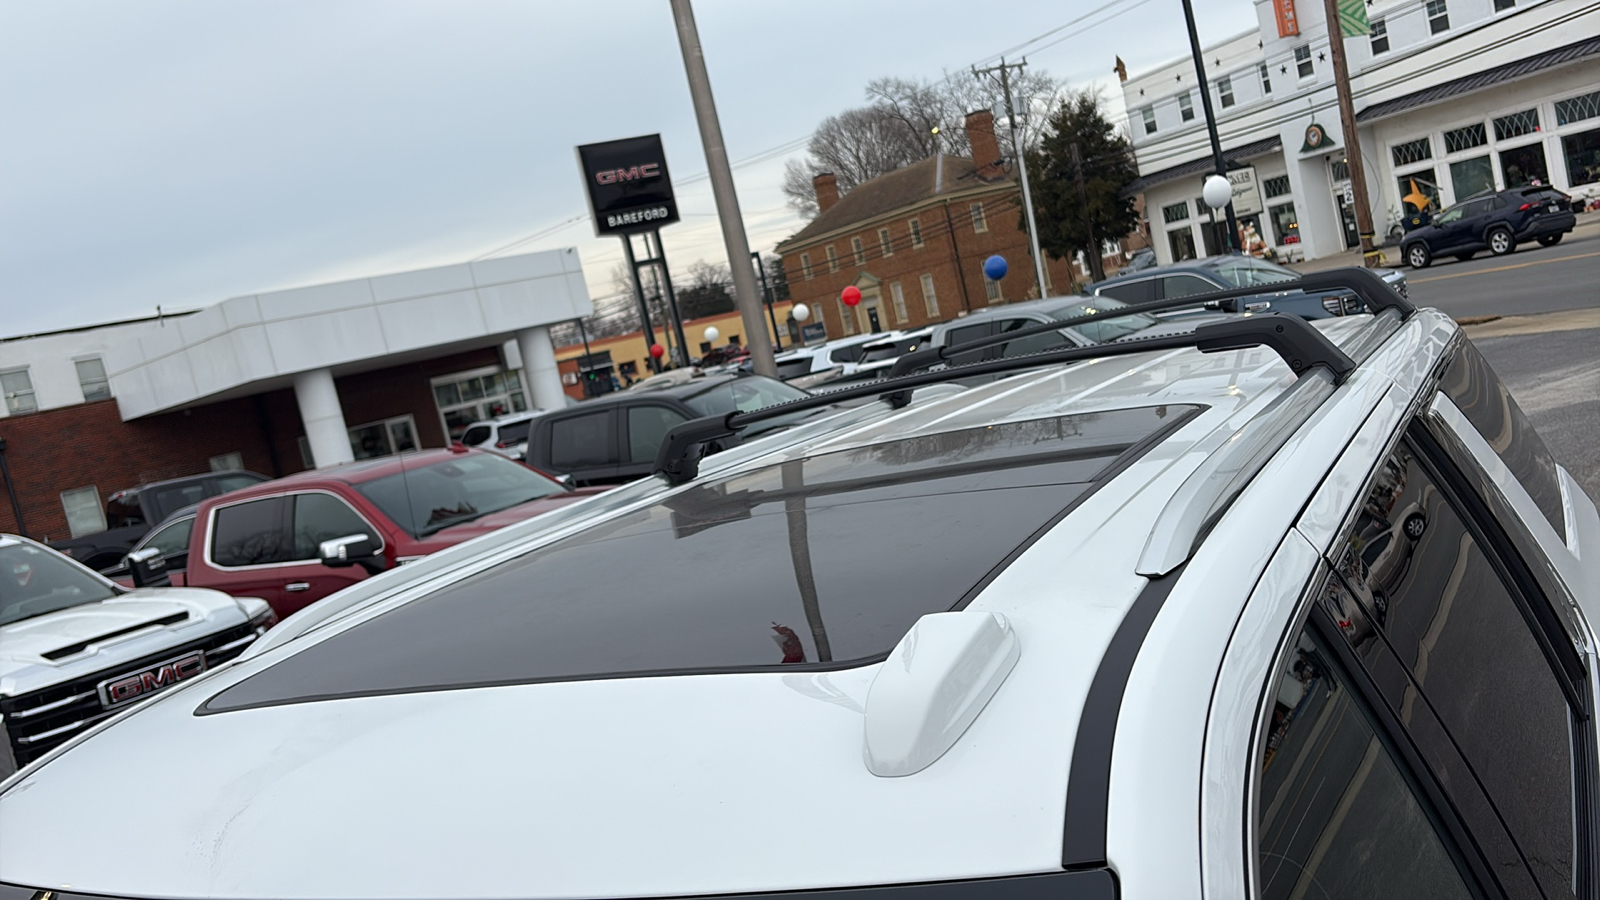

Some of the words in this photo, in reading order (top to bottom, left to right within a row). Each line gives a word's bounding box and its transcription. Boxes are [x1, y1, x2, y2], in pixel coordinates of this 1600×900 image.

[595, 162, 661, 185] GMC
[607, 205, 669, 228] BAREFORD
[110, 654, 201, 703] GMC
